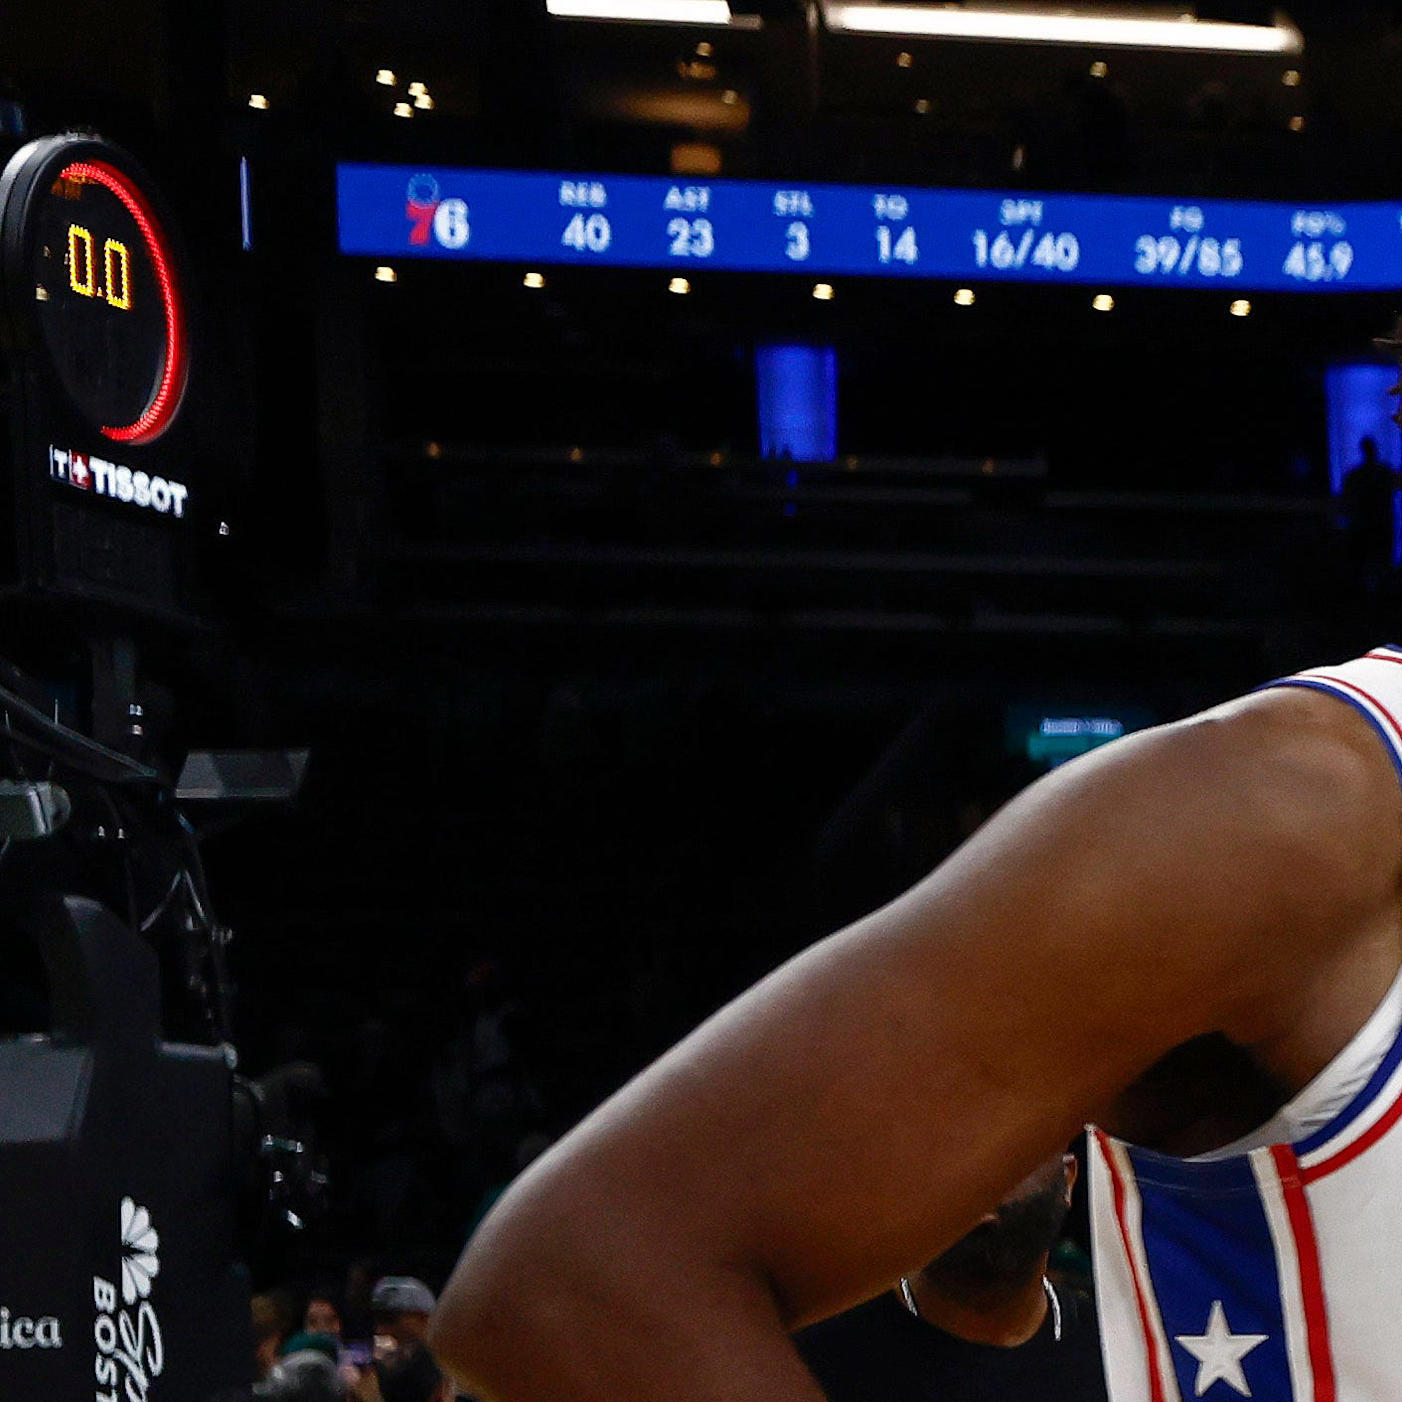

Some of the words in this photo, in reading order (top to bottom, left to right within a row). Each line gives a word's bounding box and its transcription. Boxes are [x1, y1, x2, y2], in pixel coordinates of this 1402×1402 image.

[68, 223, 131, 311] 0.0
[561, 212, 611, 252] 40
[667, 217, 714, 257] 23
[785, 221, 810, 261] 3
[876, 225, 918, 264] 14
[972, 228, 1079, 272] 16/40
[1134, 234, 1244, 276] 39/85
[1282, 240, 1354, 282] 45.9
[88, 455, 188, 519] TISSOT
[0, 1306, 63, 1349] ica
